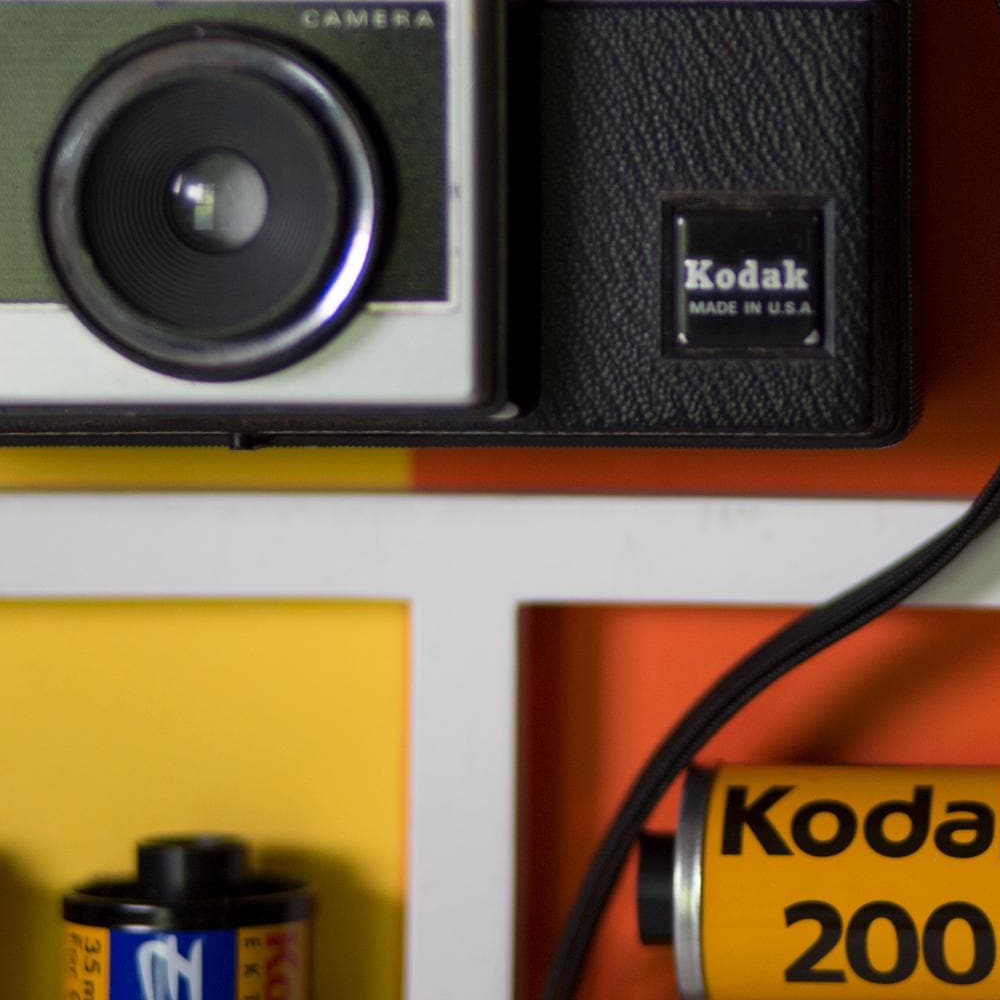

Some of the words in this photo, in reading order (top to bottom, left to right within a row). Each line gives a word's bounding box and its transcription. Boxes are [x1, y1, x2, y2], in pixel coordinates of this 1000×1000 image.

[302, 8, 435, 30] CAMERA
[684, 258, 809, 290] Kodak
[689, 301, 738, 315] MADE
[744, 301, 762, 315] IN
[783, 899, 997, 985] 200
